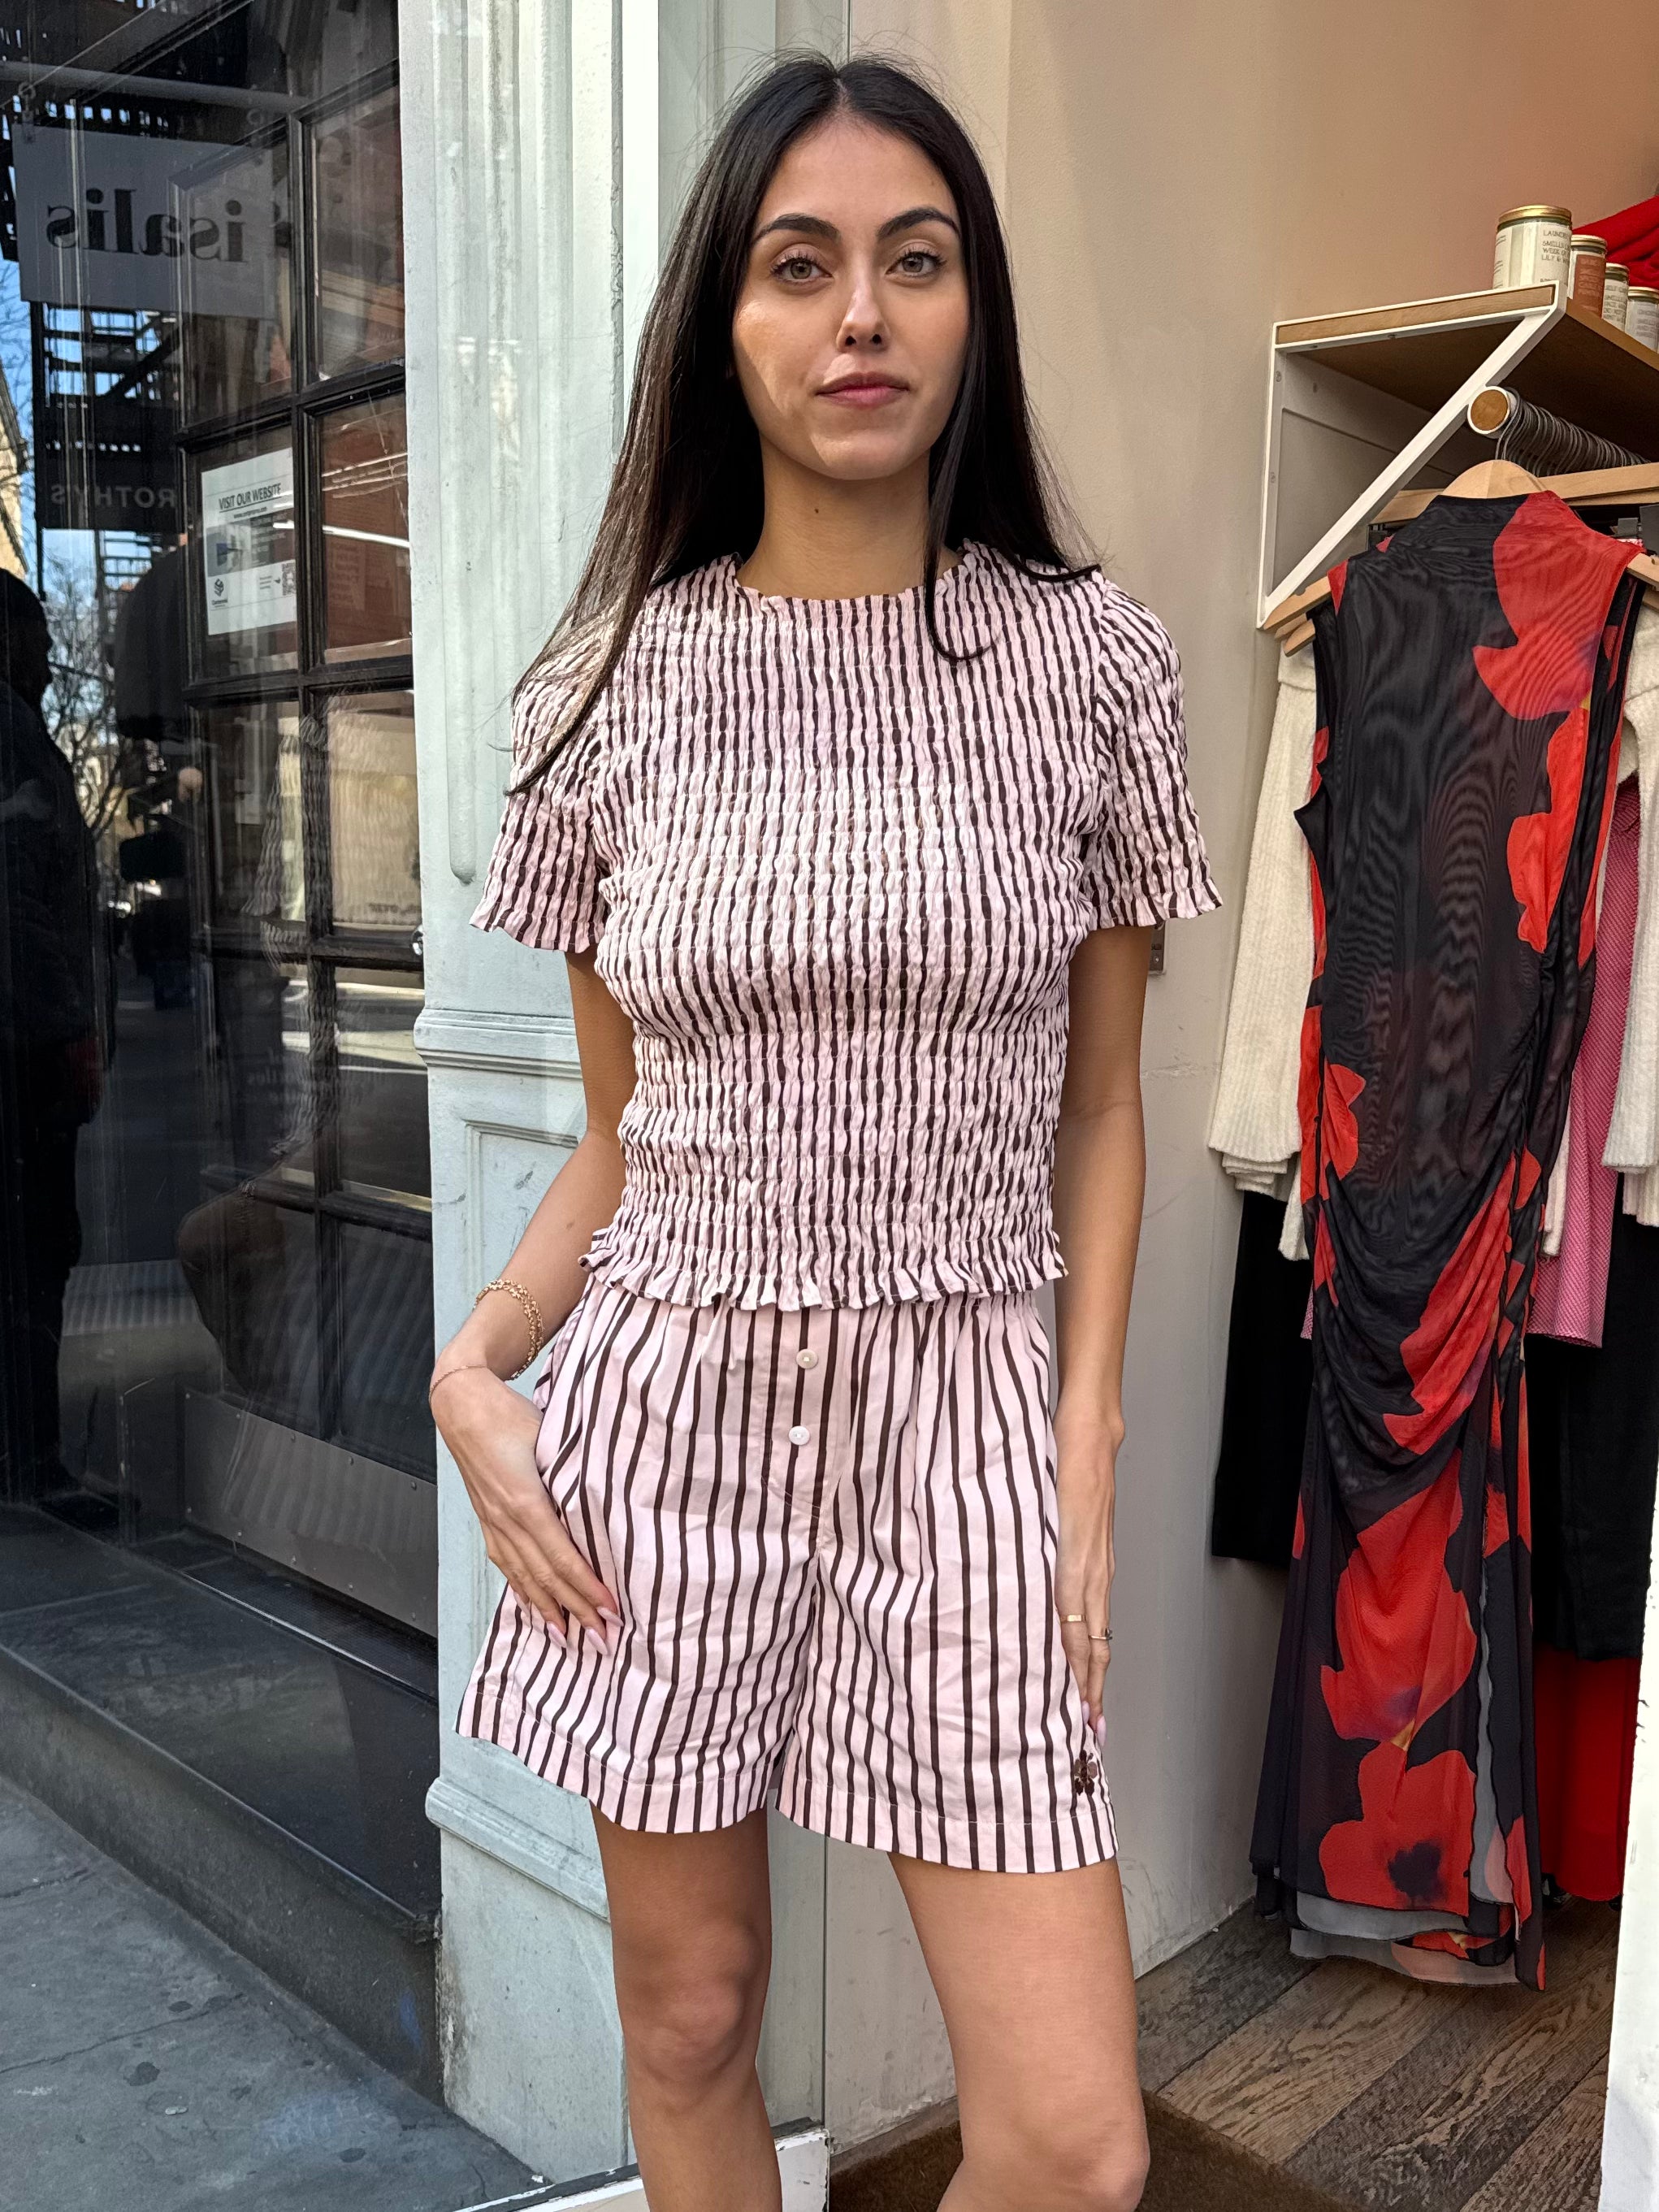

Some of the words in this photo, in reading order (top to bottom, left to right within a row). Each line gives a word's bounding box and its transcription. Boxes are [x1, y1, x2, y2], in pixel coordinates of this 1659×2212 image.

[219, 495, 235, 510] VISIT
[236, 491, 251, 506] OUR
[252, 483, 281, 501] WEBSITE
